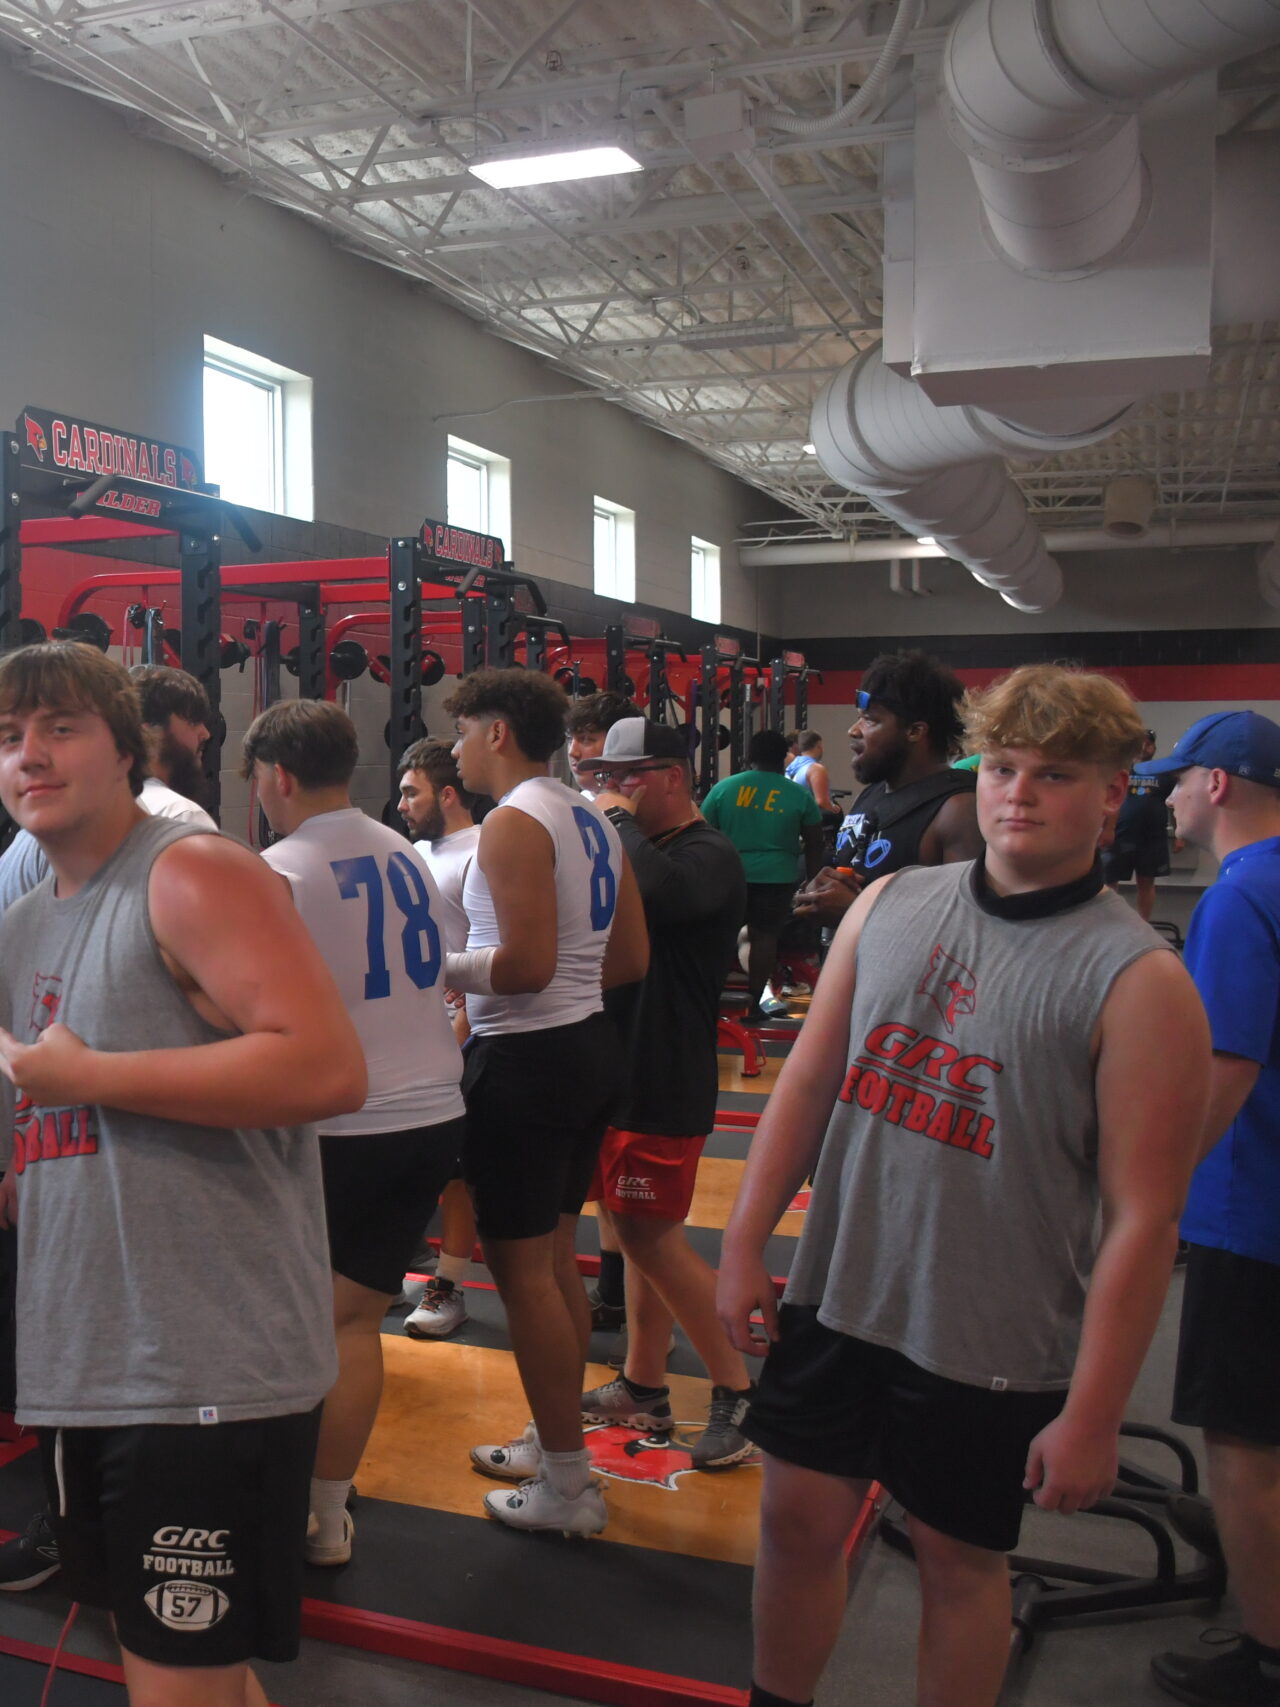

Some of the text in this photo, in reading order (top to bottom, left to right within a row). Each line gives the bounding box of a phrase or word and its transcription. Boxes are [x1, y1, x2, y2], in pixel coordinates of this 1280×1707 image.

[52, 419, 177, 488] CARDINALS
[77, 490, 162, 517] ILDER
[435, 525, 493, 569] CARDINALS
[571, 806, 616, 931] 8
[329, 851, 442, 1000] 78
[864, 1021, 1004, 1094] GRC
[837, 1063, 996, 1160] FOOTBALL
[617, 1175, 653, 1187] GRC
[152, 1525, 231, 1549] GRC
[143, 1554, 235, 1577] FOOTBALL
[170, 1594, 202, 1618] 57
